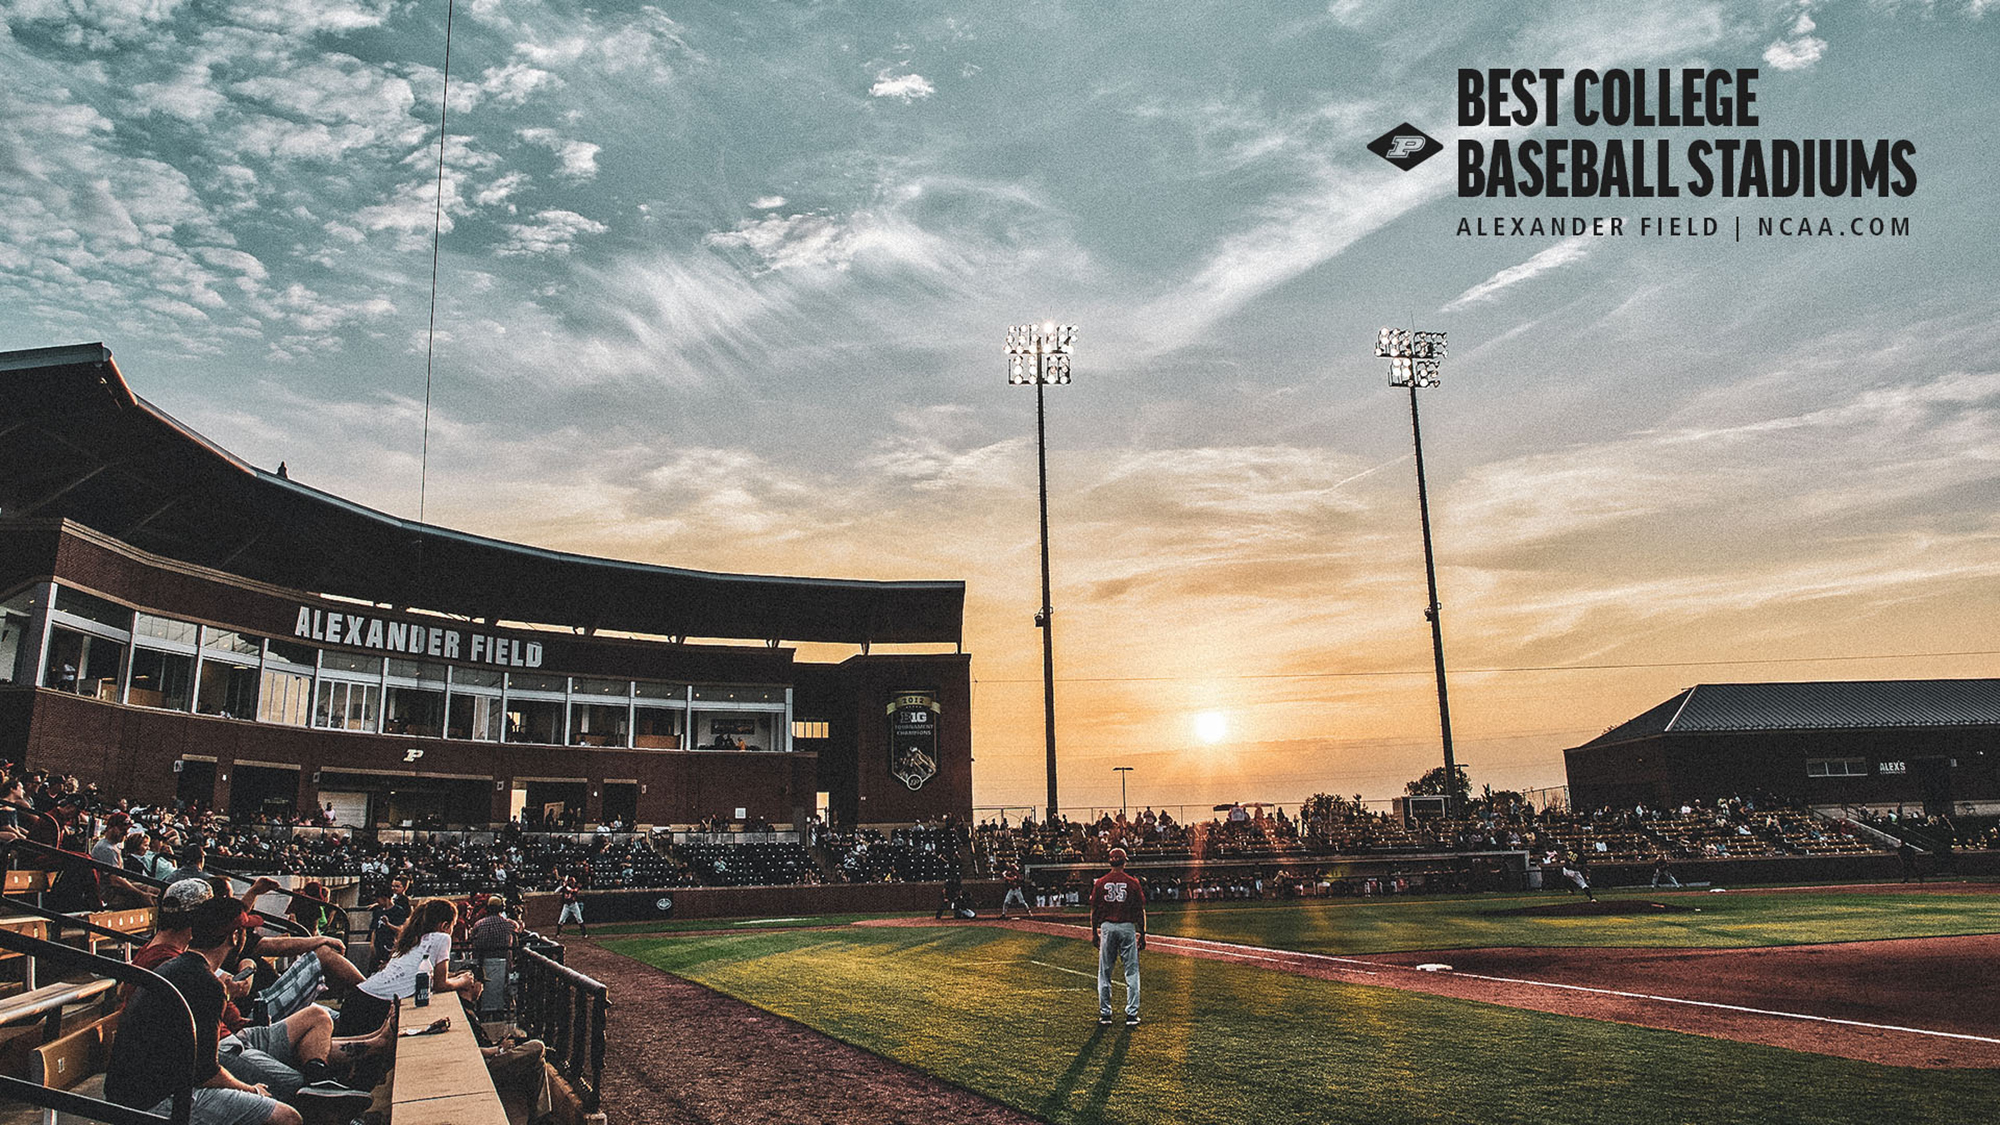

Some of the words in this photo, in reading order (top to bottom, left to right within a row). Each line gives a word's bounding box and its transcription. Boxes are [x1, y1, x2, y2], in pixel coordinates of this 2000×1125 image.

[295, 606, 461, 659] ALEXANDER
[471, 633, 543, 668] FIELD
[403, 748, 424, 762] P
[1879, 760, 1906, 771] ALEX'S
[1103, 882, 1128, 903] 35
